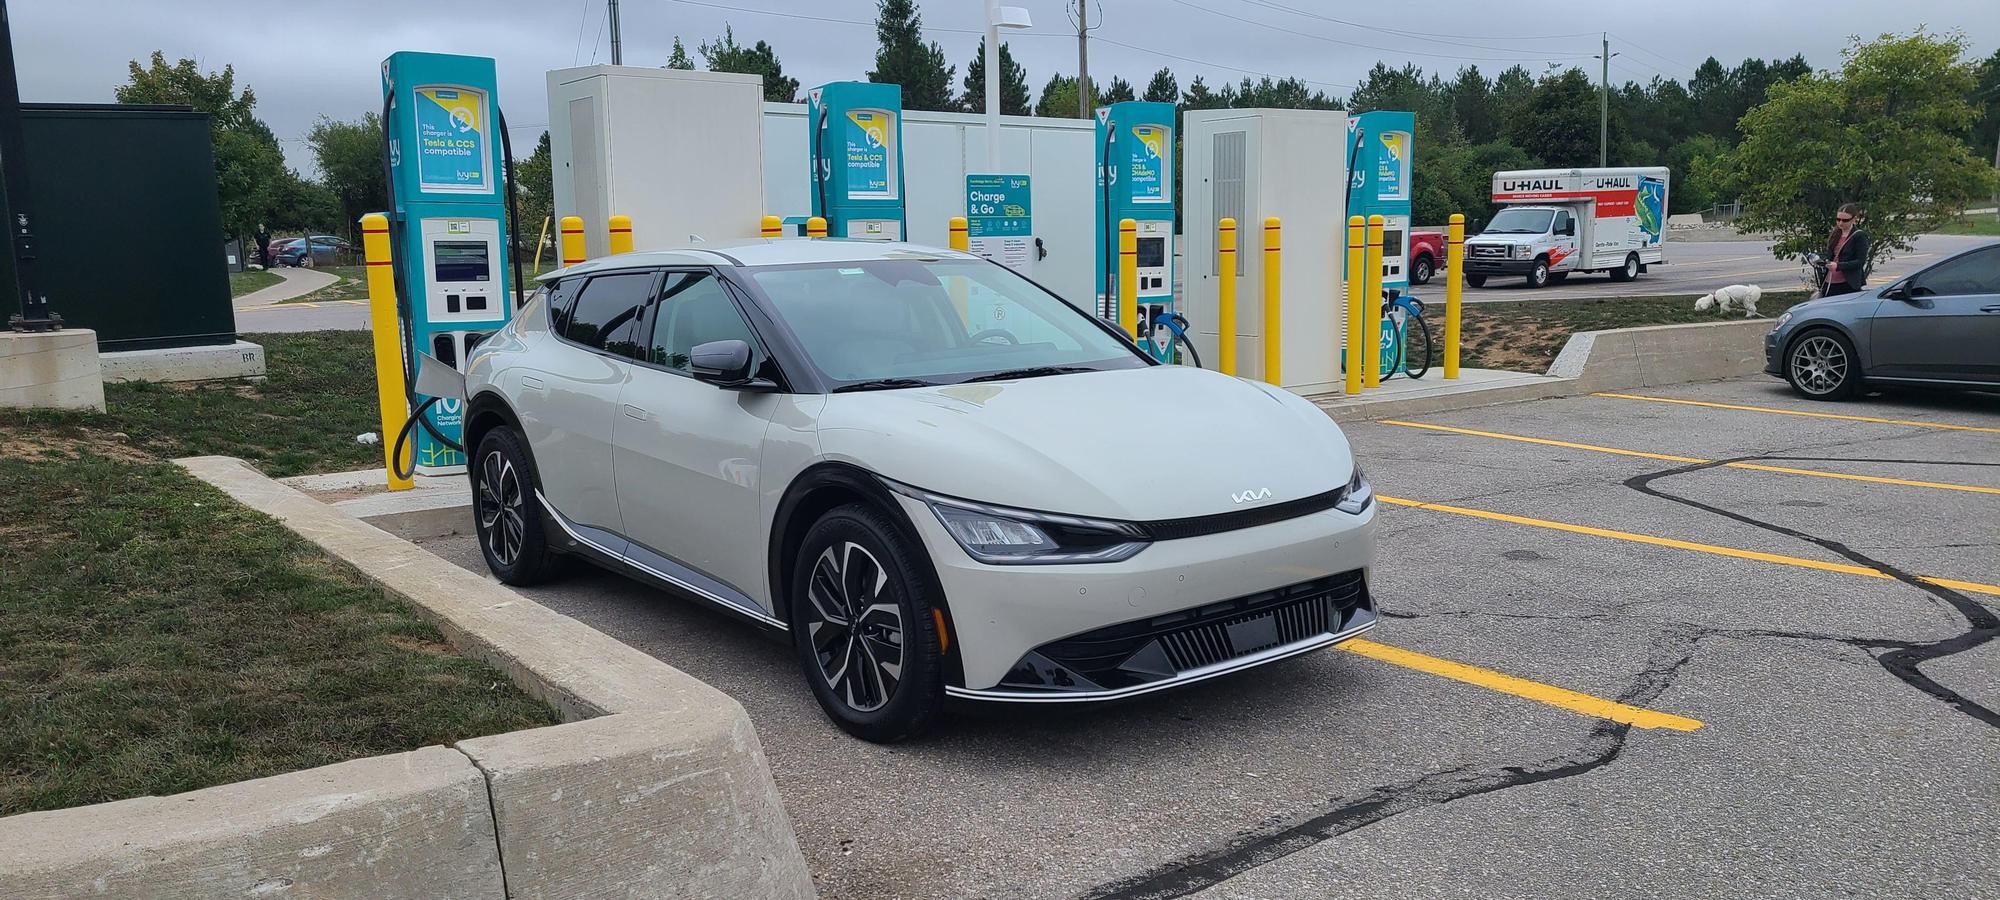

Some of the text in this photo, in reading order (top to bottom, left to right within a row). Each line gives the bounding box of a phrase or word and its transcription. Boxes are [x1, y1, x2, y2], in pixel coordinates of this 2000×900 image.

[424, 138, 475, 148] Tesla & CCS
[424, 148, 472, 157] compatible
[1503, 180, 1563, 191] U-HAUL
[1596, 177, 1630, 188] U-HAUL
[970, 190, 1005, 203] Charge
[970, 204, 994, 214] & Go
[242, 352, 255, 362] BR
[1231, 487, 1272, 504] KIA
